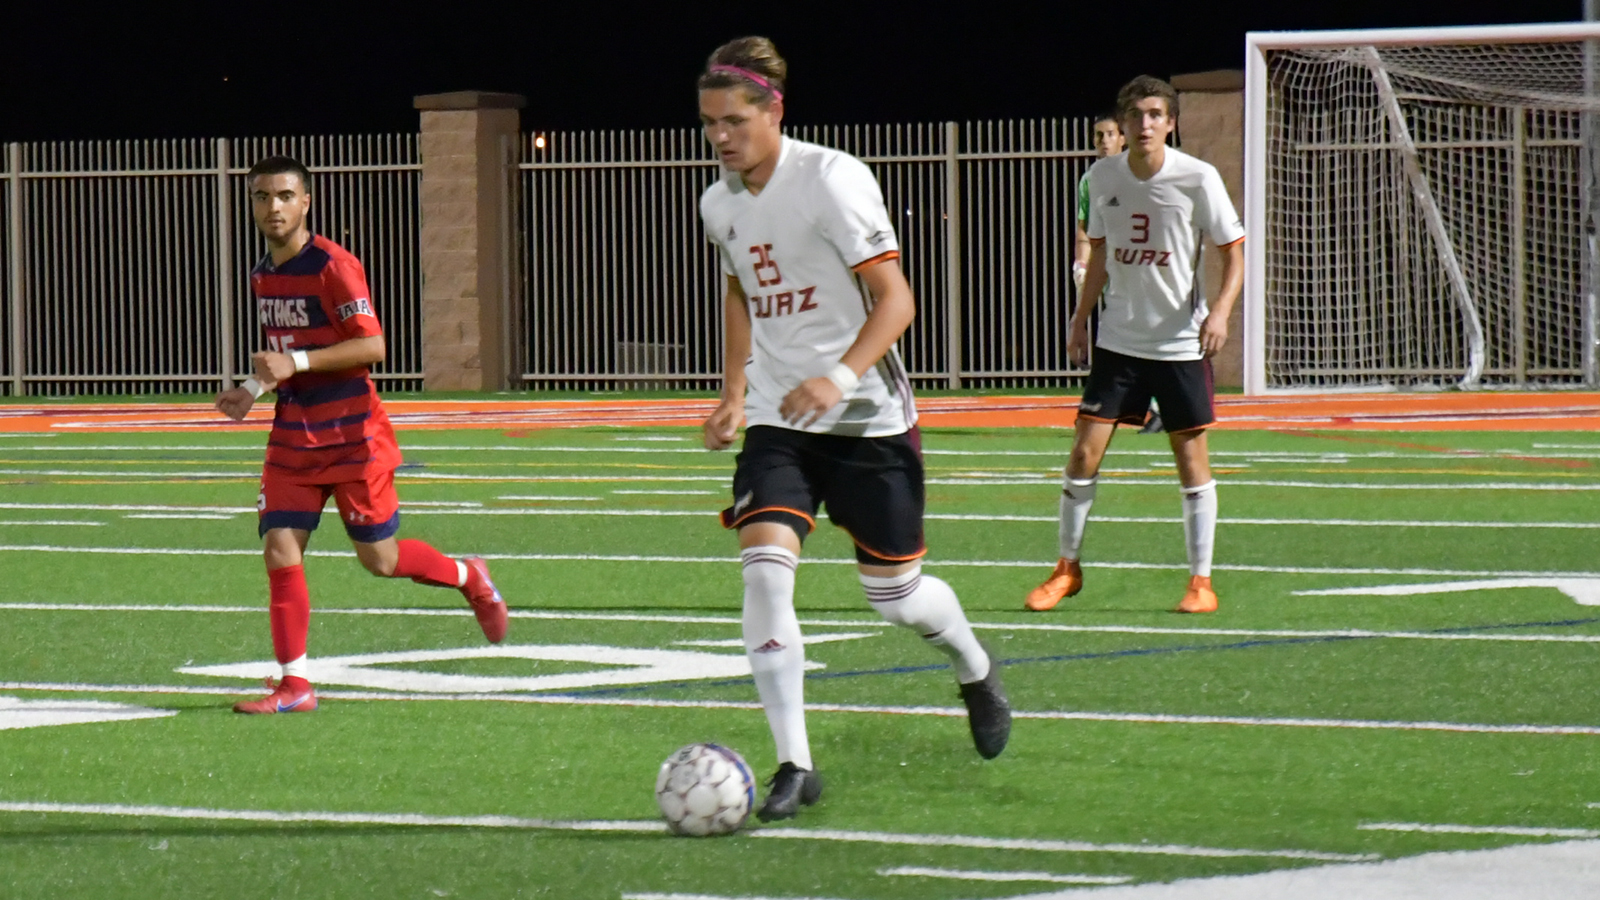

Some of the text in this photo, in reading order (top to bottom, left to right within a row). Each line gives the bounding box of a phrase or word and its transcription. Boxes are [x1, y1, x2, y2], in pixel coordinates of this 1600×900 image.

[1130, 213, 1150, 243] 3
[749, 243, 782, 287] 25
[750, 285, 819, 319] UAZ
